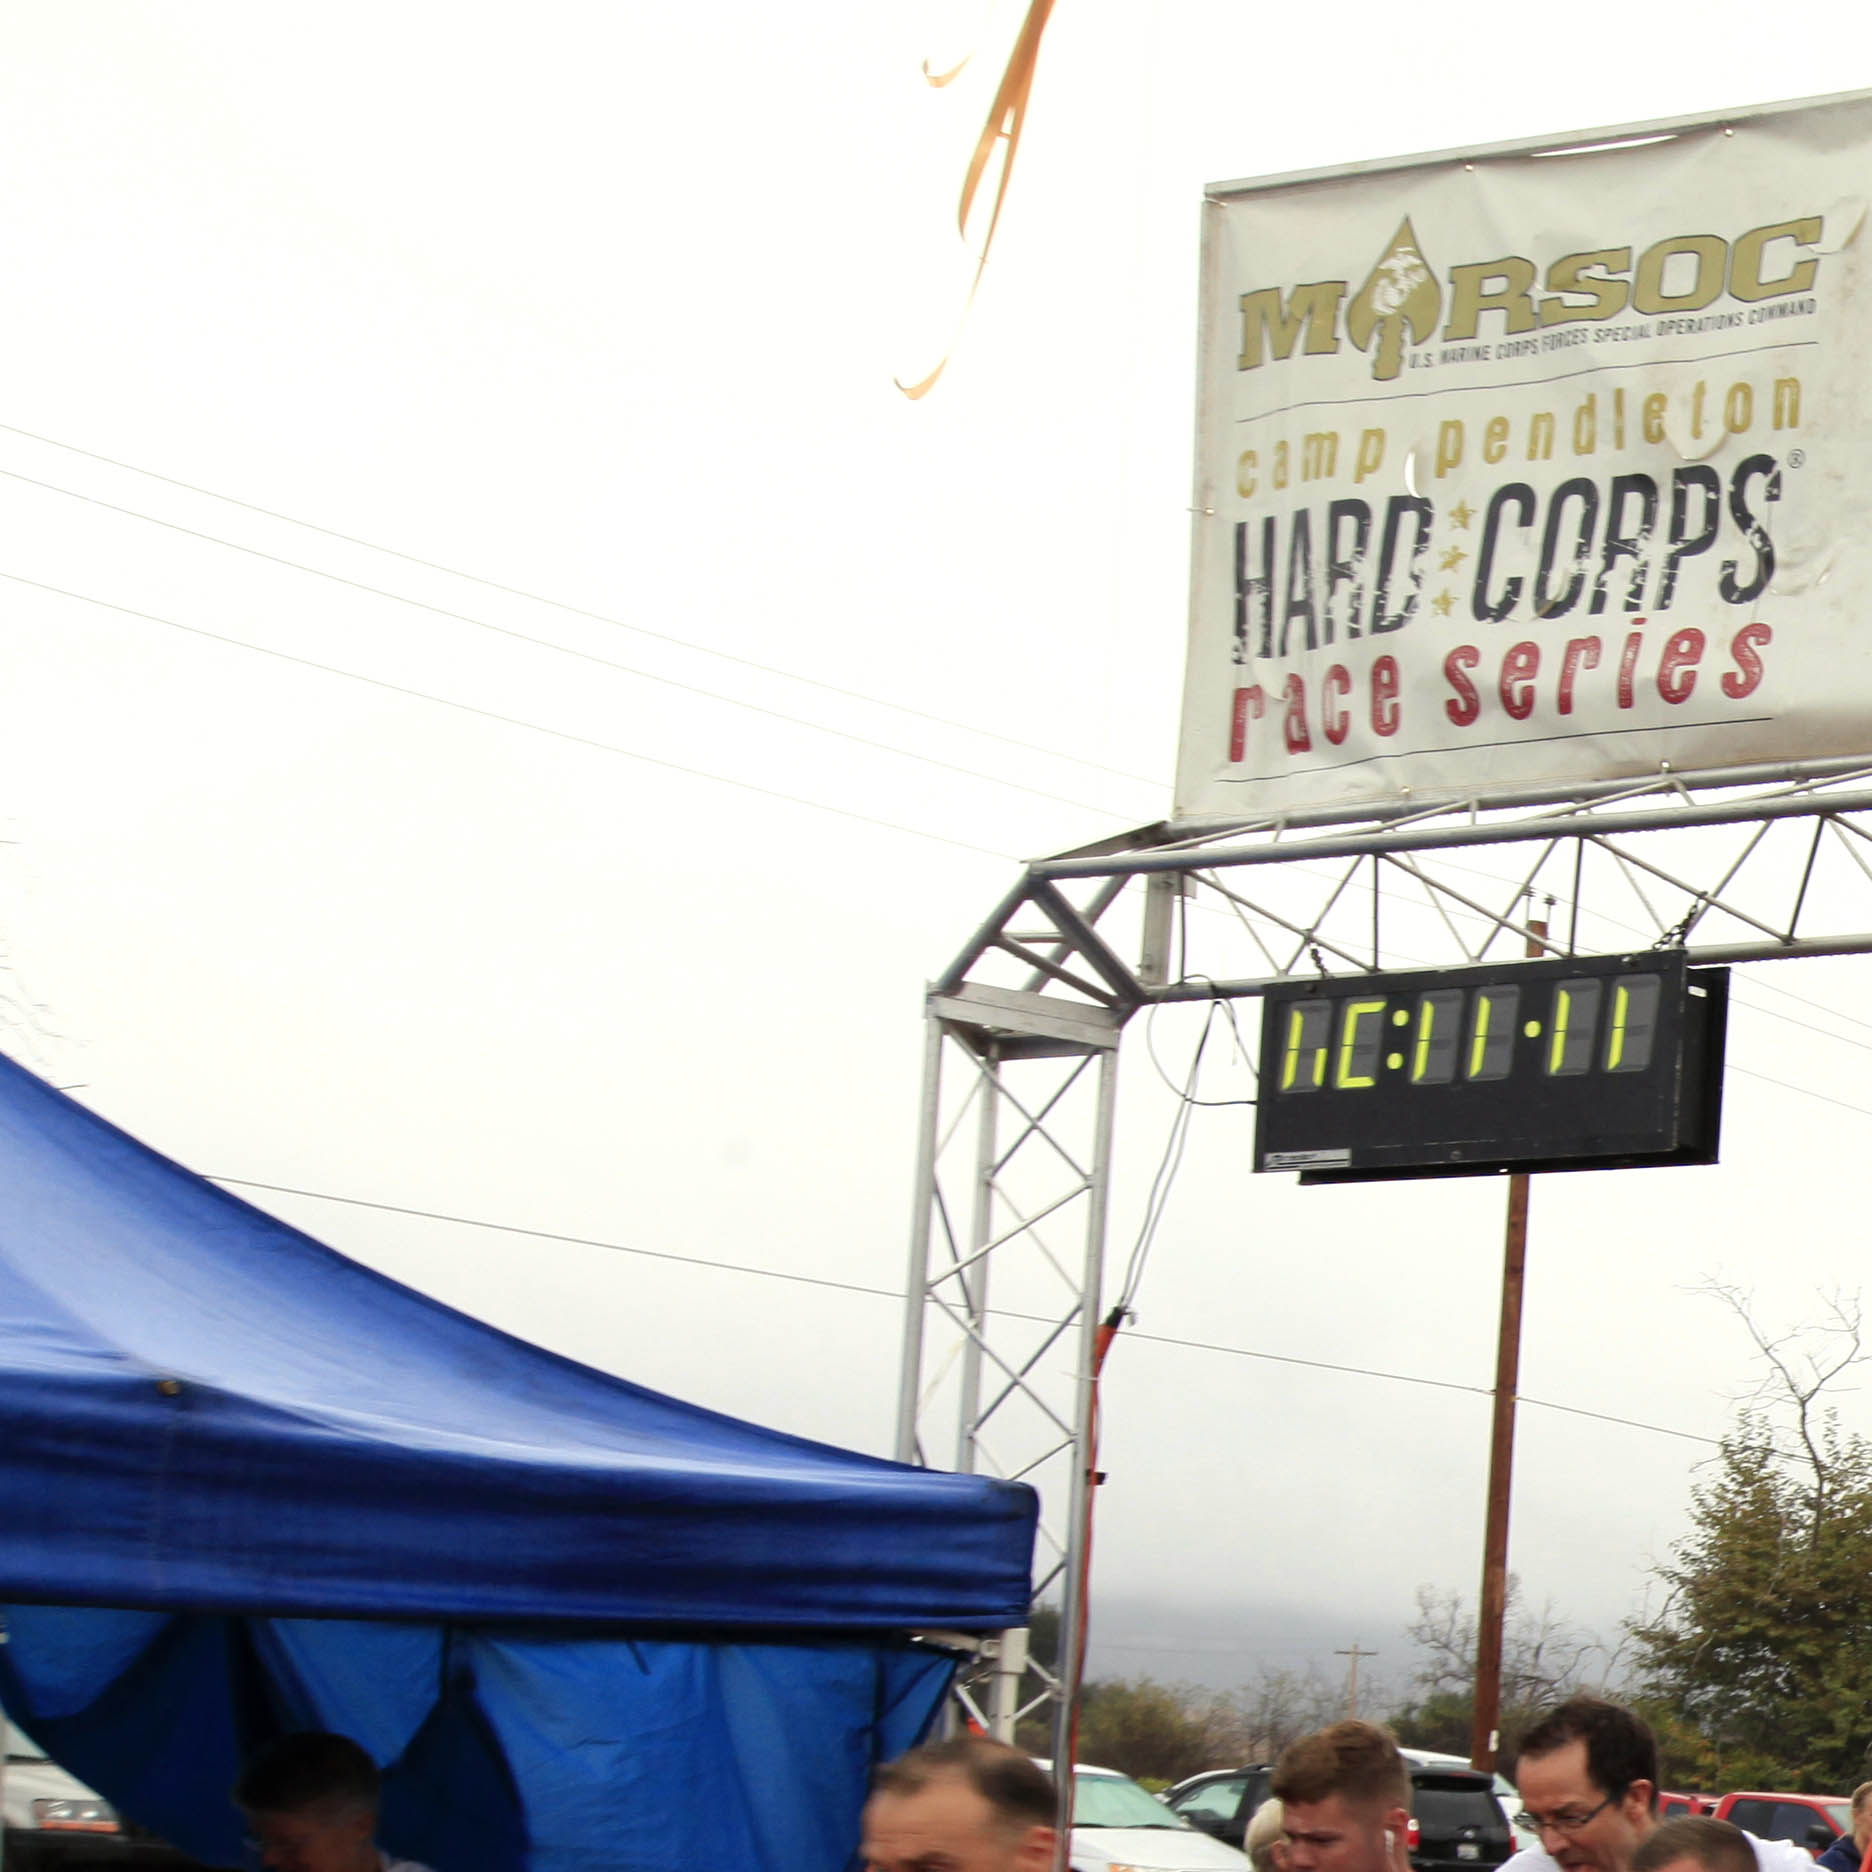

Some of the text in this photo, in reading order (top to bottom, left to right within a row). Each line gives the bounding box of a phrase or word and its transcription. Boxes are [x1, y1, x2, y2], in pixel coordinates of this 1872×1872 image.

[1440, 344, 1490, 366] MARINE
[1496, 338, 1540, 361] CORPS
[1541, 327, 1590, 352] FORCES
[1592, 320, 1651, 344] SPECIAL
[1656, 311, 1745, 337] OPERATIONS
[1749, 298, 1818, 325] COMMAND
[1236, 375, 1802, 499] camp pendleton
[1231, 453, 1784, 666] HARD CORPS
[1229, 617, 1775, 763] race series
